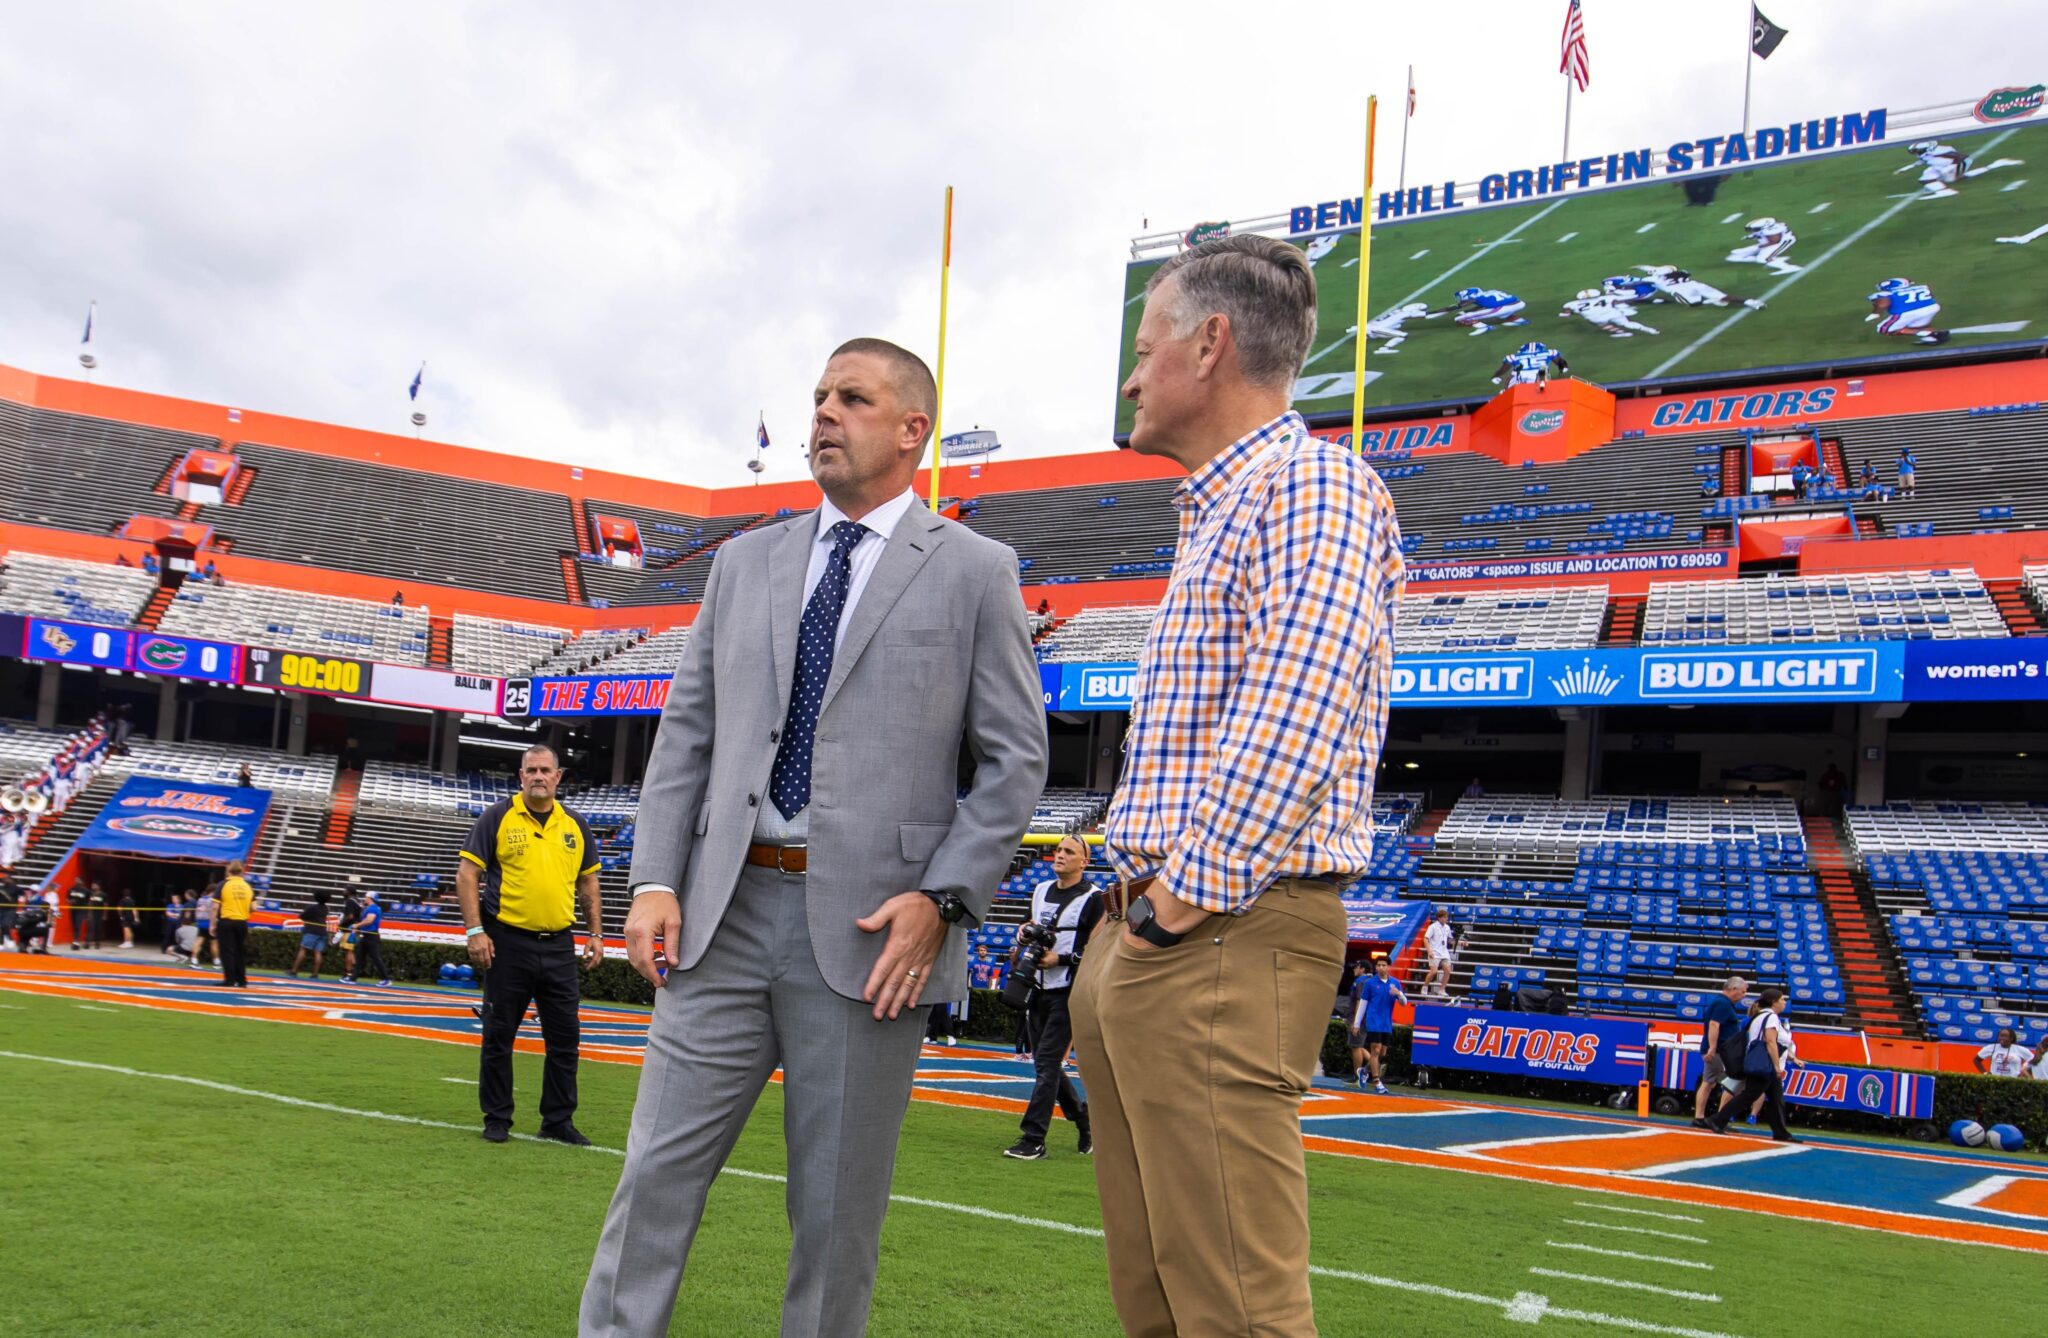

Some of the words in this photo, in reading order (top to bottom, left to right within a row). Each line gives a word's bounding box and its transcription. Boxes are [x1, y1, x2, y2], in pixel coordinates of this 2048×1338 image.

[1290, 198, 1363, 234] BEN
[1378, 181, 1463, 219] HILL
[1478, 148, 1652, 203] GRIFFIN
[1666, 107, 1888, 174] STADIUM
[1651, 387, 1837, 428] GATORS
[1318, 423, 1454, 454] ORIDA
[1405, 569, 1422, 581] XT
[1482, 564, 1527, 578] <space>
[1530, 561, 1564, 575] ISSUE
[1566, 560, 1593, 573] AND
[1595, 556, 1658, 572] LOCATION
[1660, 555, 1678, 568] TO
[1681, 553, 1722, 567] 69050
[92, 632, 111, 659] 0
[250, 648, 270, 663] QTR
[200, 646, 219, 673] 0
[254, 663, 264, 682] 1
[1650, 662, 1735, 688] BUD
[1740, 658, 1865, 687] LIGHT
[1926, 660, 2039, 679] women’s
[279, 653, 361, 694] 90:00
[454, 675, 478, 690] BALL
[479, 678, 493, 692] ON
[1419, 666, 1524, 692] LIGHT
[505, 687, 529, 709] 25
[539, 681, 590, 711] THE
[592, 679, 673, 710] SWAM
[162, 789, 231, 806] THE
[1467, 1017, 1488, 1026] ONLY
[1453, 1023, 1600, 1066] GATORS
[1528, 1060, 1544, 1068] GET
[1545, 1062, 1562, 1070] OUT
[1562, 1064, 1587, 1072] ALIVE
